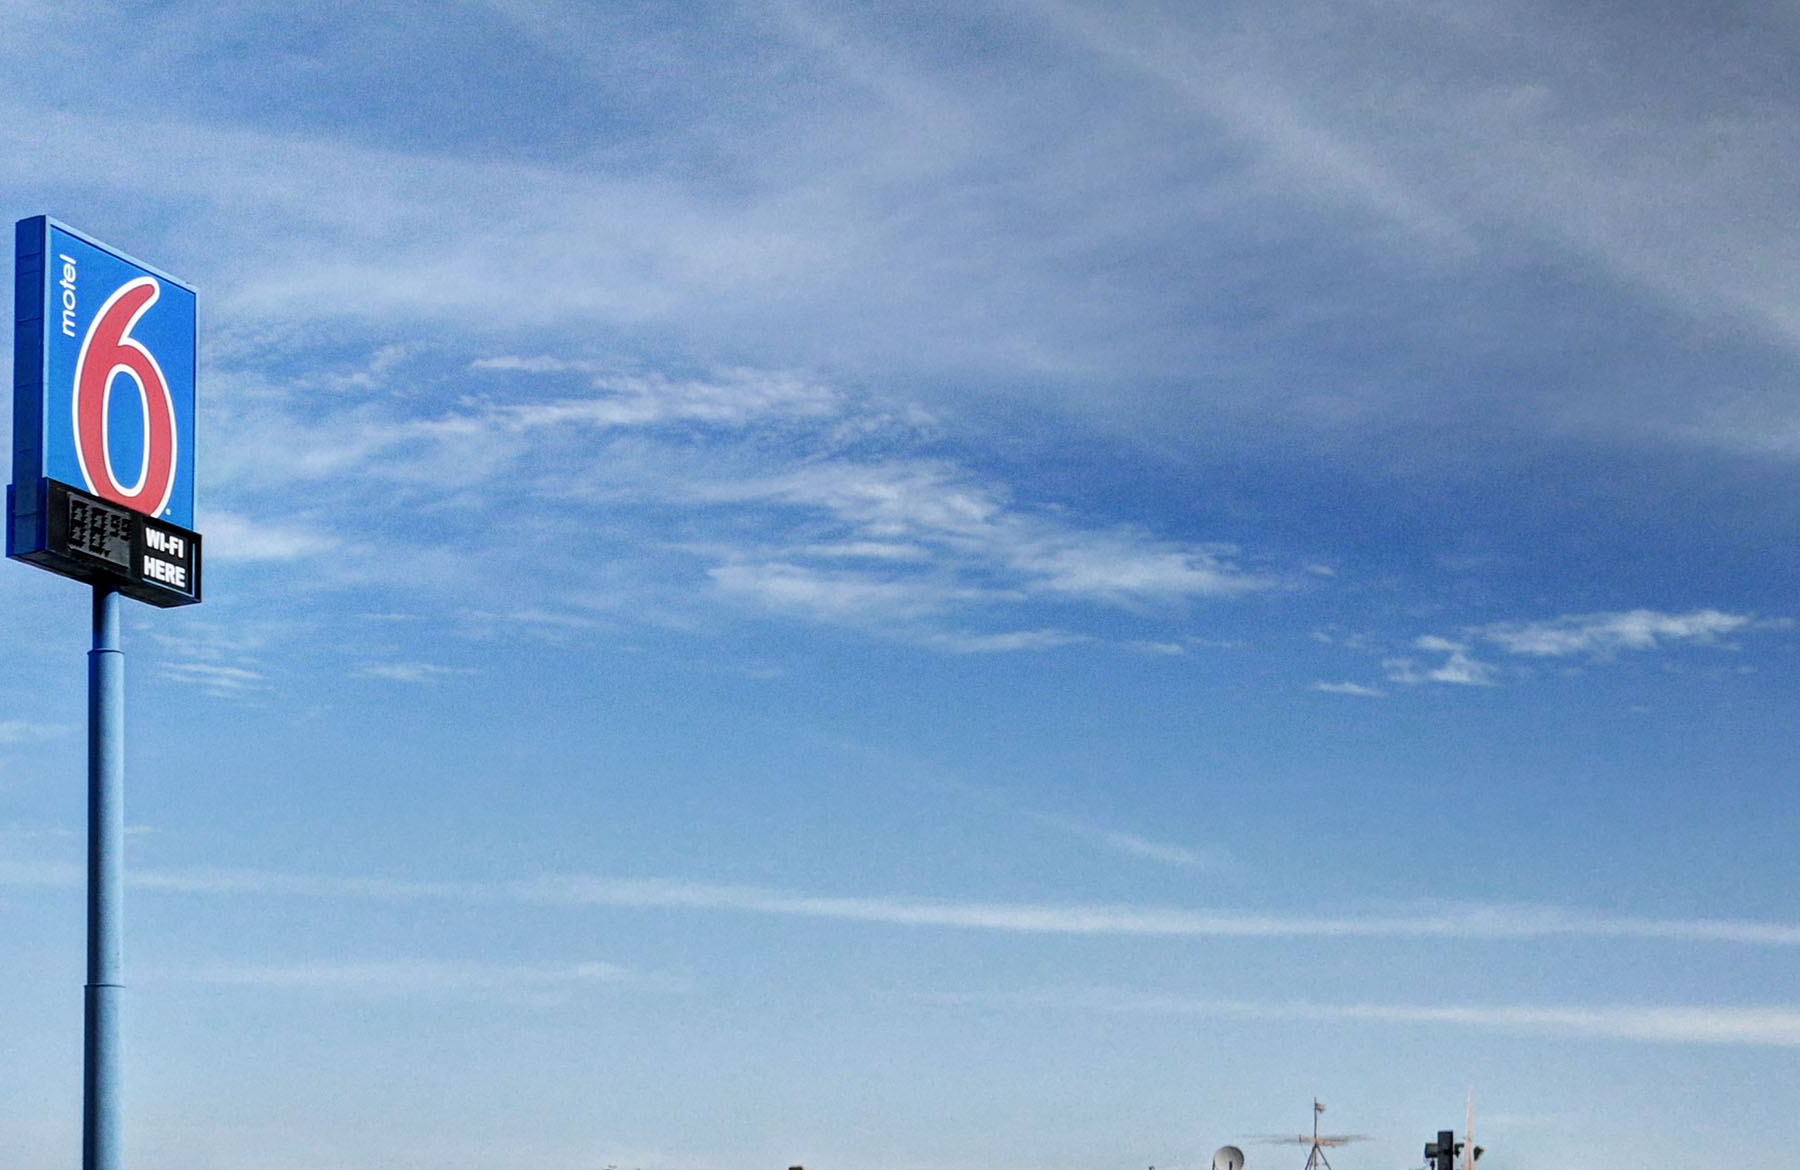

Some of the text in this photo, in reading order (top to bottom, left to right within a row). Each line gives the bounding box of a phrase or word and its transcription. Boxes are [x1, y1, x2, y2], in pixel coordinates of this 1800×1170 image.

[59, 253, 77, 337] motel
[72, 276, 177, 518] 6
[144, 555, 186, 588] HERE
[145, 527, 184, 559] WI-FI
